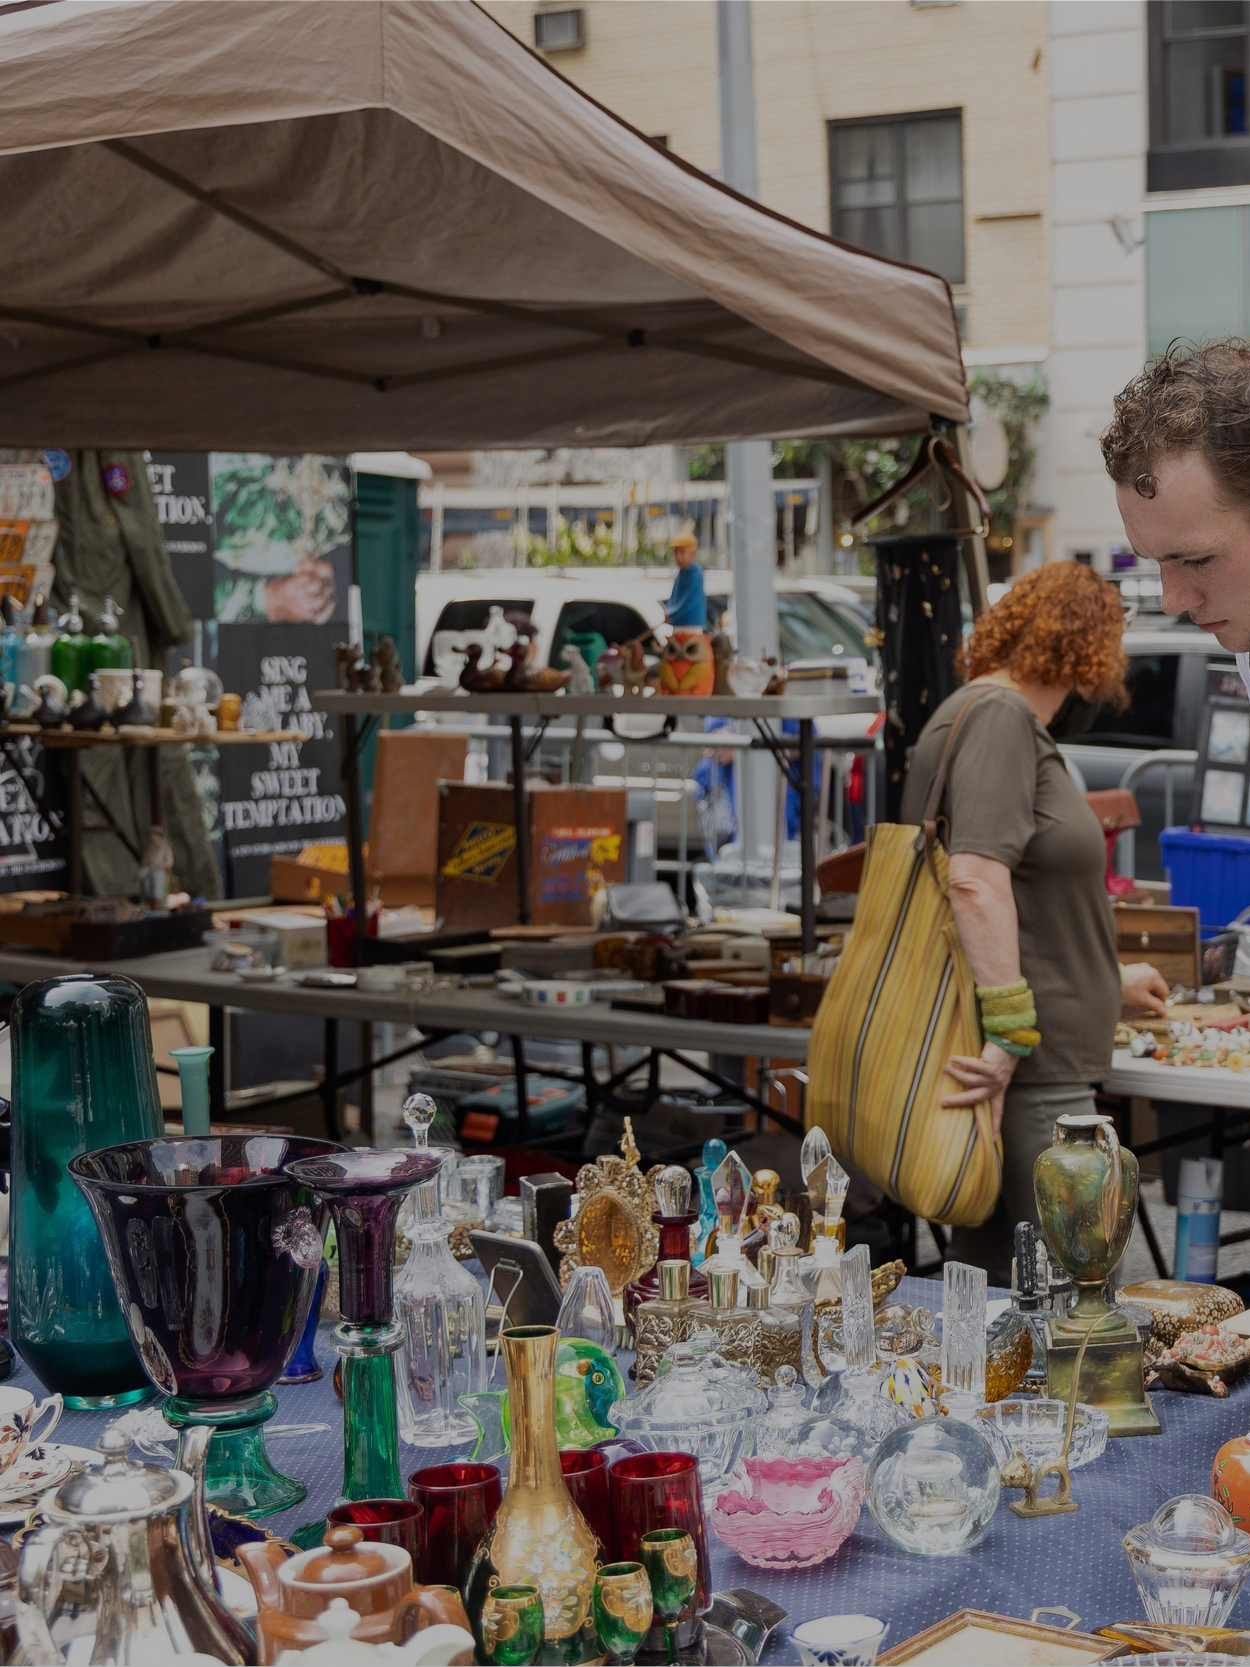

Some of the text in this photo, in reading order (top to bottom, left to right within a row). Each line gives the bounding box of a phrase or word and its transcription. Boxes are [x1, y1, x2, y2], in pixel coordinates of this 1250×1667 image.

[147, 464, 176, 494] ET
[153, 494, 214, 524] TION.
[260, 656, 308, 685] SING
[269, 741, 303, 770] MY
[250, 767, 322, 800] SWEET
